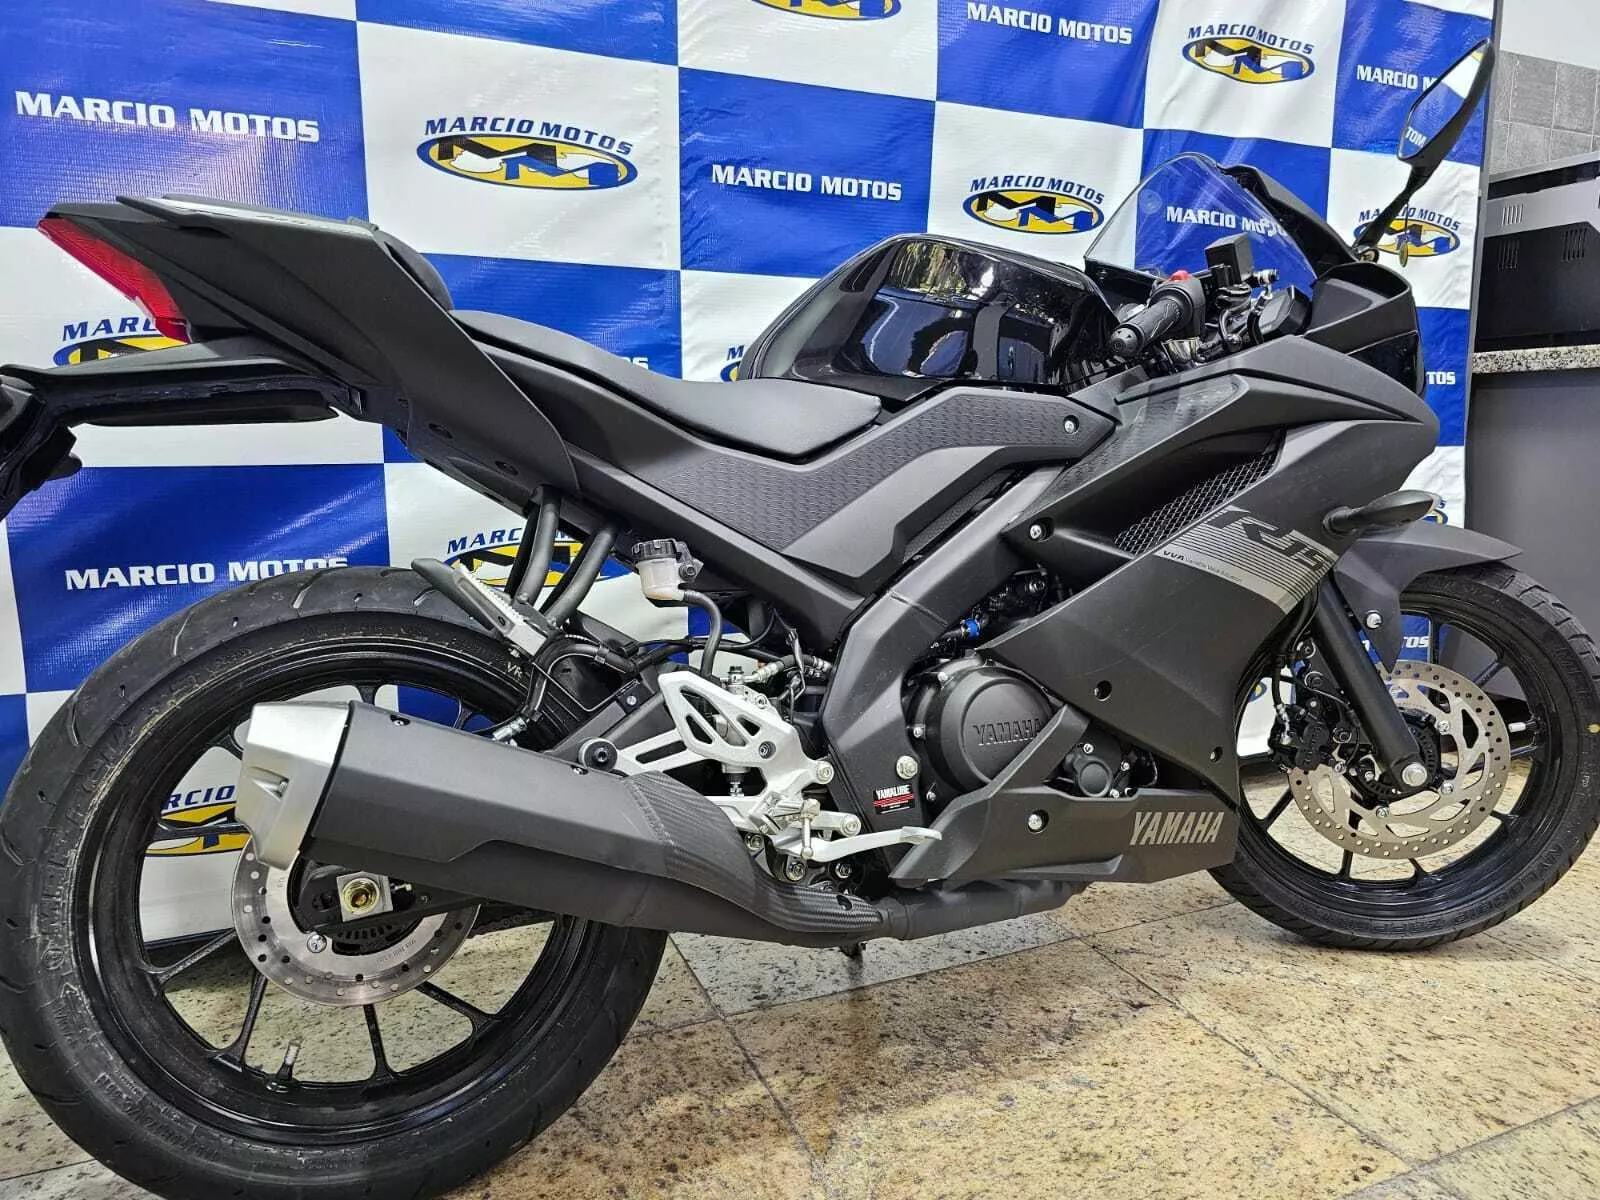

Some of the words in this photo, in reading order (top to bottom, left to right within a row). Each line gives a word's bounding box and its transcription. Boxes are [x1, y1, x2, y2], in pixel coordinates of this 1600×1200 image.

[966, 2, 1051, 34] MARCIO
[1058, 19, 1132, 45] MOTOS
[1188, 23, 1257, 39] MARCIO
[1257, 29, 1315, 55] MOTOS
[1356, 64, 1418, 90] MARCIO
[15, 90, 175, 129] MARCIO
[190, 107, 320, 143] MOTOS
[424, 116, 535, 136] MARCIO
[539, 121, 634, 156] MOTOS
[712, 164, 812, 192] MARCIO
[821, 175, 902, 201] MOTOS
[970, 175, 1045, 192] MARCIO
[1047, 178, 1105, 205] MOTOS
[1166, 206, 1236, 229] MARCIO
[1418, 208, 1462, 231] MOTOS
[1426, 371, 1456, 385] TOS
[447, 527, 522, 553] MARC
[65, 562, 214, 590] MARCIO
[166, 785, 236, 809] RCIO
[1129, 811, 1225, 846] YAMAHA
